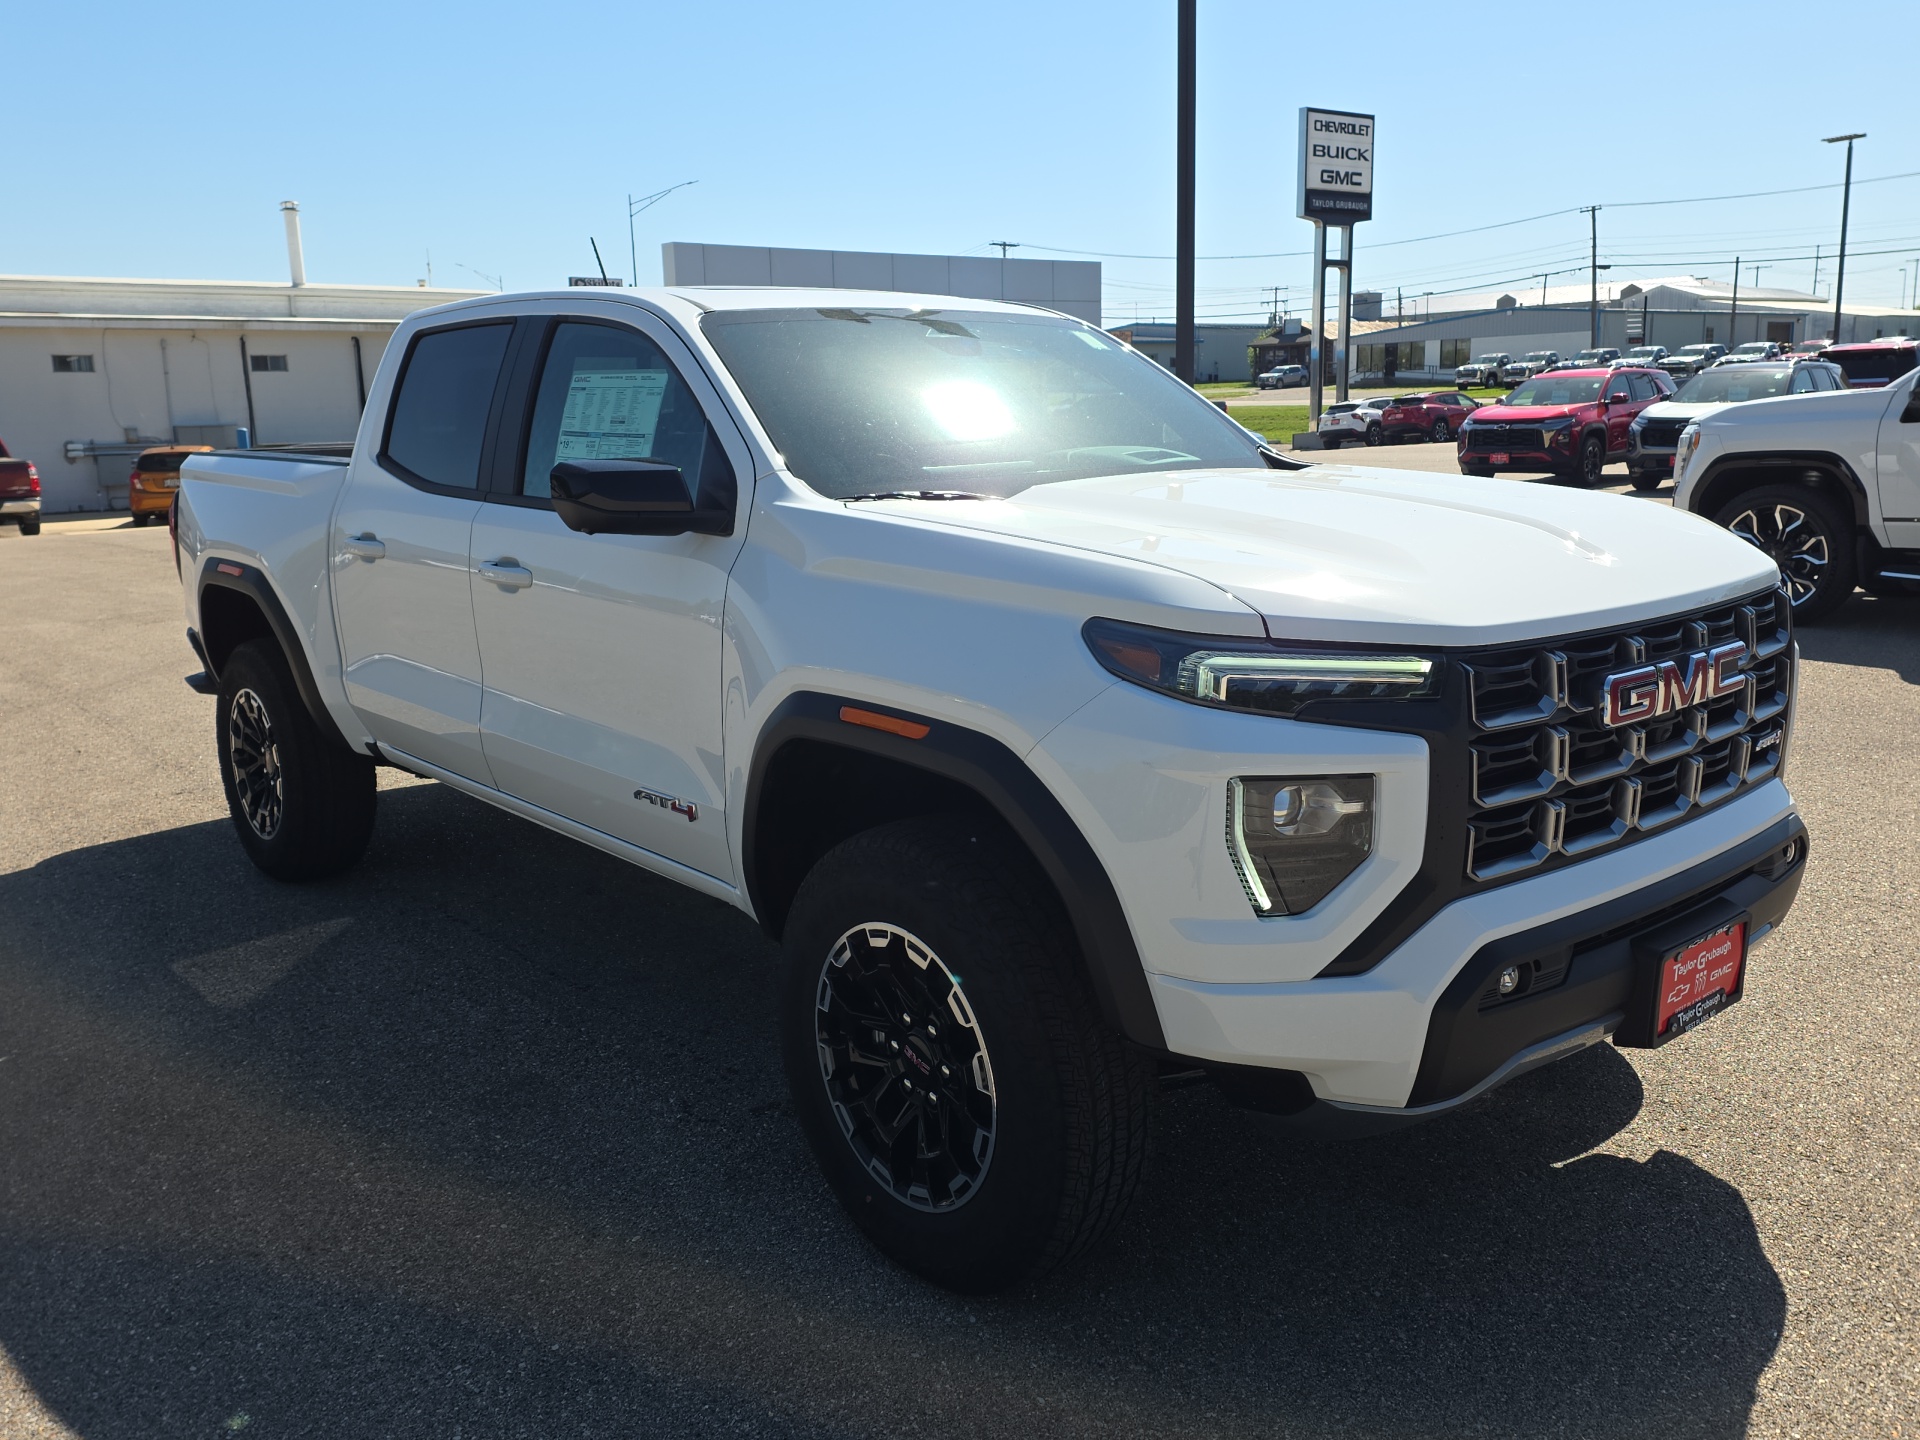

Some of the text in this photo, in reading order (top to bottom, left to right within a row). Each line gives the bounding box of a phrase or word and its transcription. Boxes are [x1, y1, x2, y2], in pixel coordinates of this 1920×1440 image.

[1314, 119, 1371, 137] CHEVROLET
[1312, 144, 1370, 162] BUICK
[1320, 169, 1363, 187] GMC
[1312, 198, 1368, 210] TAYLOR GRUBAUGH
[1603, 640, 1747, 729] GMC
[633, 786, 699, 823] AT4
[1673, 940, 1732, 982] Taylor Grubaugh
[1710, 962, 1734, 982] GMC
[1677, 1008, 1696, 1027] Taylor
[1695, 993, 1721, 1017] Grubaugh
[903, 1044, 931, 1076] GMC
